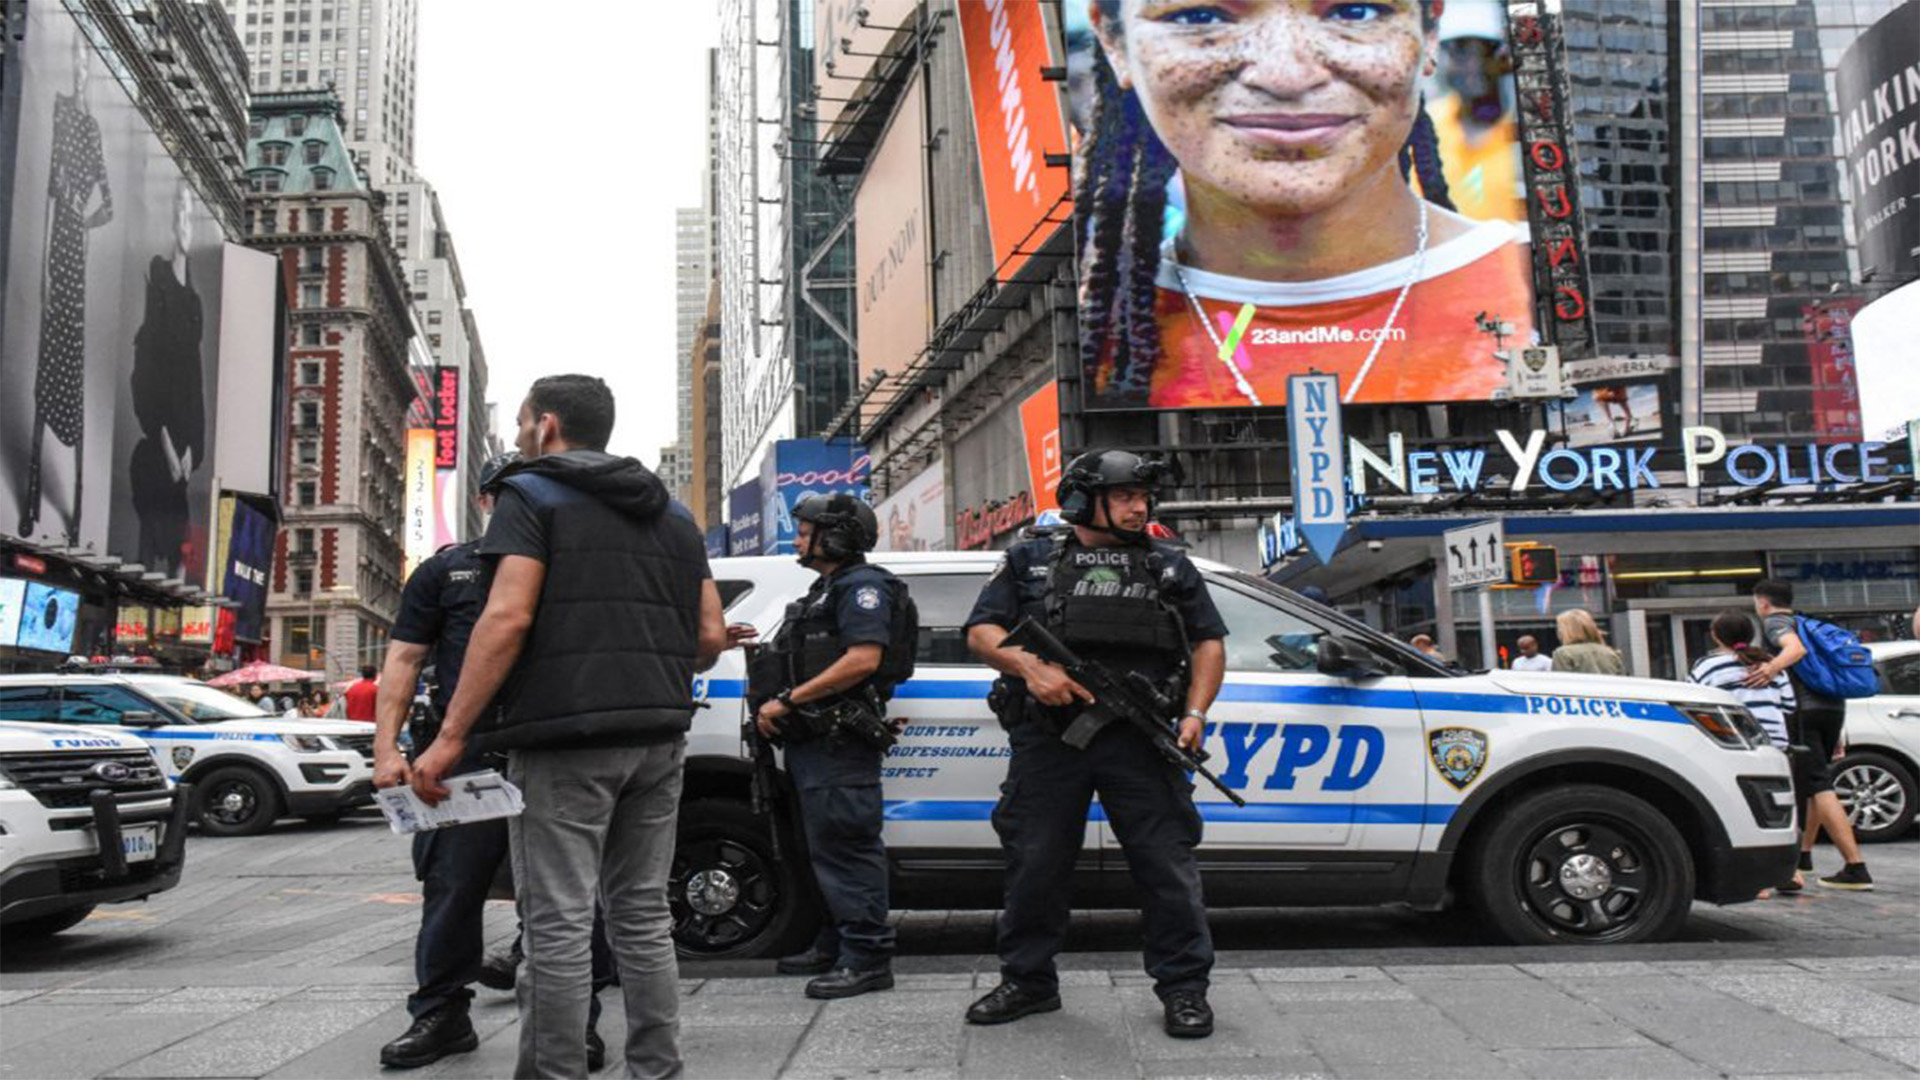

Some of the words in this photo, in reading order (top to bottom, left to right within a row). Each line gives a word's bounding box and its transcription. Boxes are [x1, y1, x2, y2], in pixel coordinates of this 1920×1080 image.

[984, 0, 1037, 191] UNKIN'
[1855, 121, 1920, 195] YORK
[1864, 196, 1907, 233] WALKER
[863, 257, 886, 313] OUT
[887, 208, 917, 281] NOW
[1251, 326, 1406, 345] 23andMe.com
[436, 368, 456, 425] Locker
[435, 428, 455, 466] Foot
[1303, 381, 1335, 519] NYPD
[1349, 431, 1485, 494] NEW
[1495, 429, 1660, 492] YORK
[1682, 425, 1890, 488] POLICE
[776, 454, 872, 486] pool
[956, 490, 1036, 550] Walgreens
[1076, 553, 1130, 565] POLICE
[1529, 696, 1620, 717] POLICE
[902, 726, 979, 737] OURTESY
[889, 746, 1018, 757] ROFESSIONALIS
[1190, 722, 1386, 791] YPD
[879, 767, 939, 778] ESPECT
